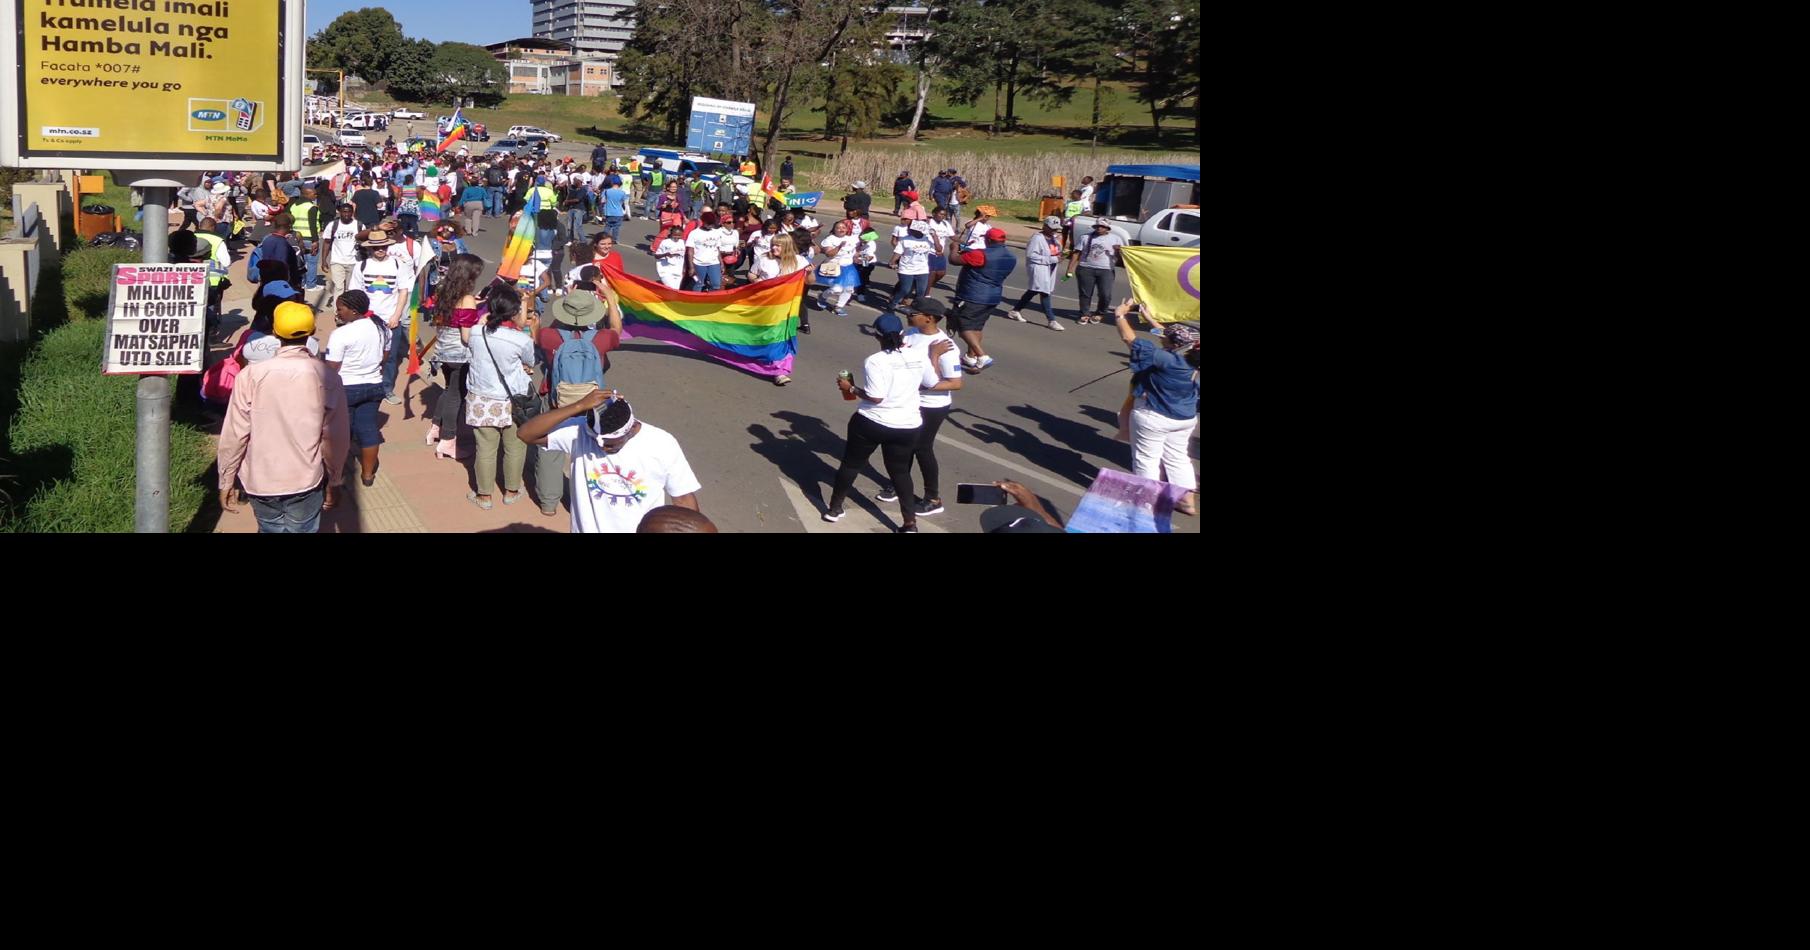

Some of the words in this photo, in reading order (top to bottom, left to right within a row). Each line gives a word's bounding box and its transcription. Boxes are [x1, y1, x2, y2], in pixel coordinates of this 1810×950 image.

[165, 0, 229, 18] imali
[41, 12, 170, 35] kamelula
[178, 23, 228, 43] nga
[41, 35, 141, 55] Hamba
[150, 41, 213, 60] Mali.
[41, 61, 91, 72] Facata
[41, 77, 128, 88] everywhere
[132, 80, 159, 90] you
[162, 82, 182, 92] go
[117, 267, 204, 285] SPORTS
[127, 285, 194, 301] MHLUME
[123, 302, 139, 317] IN
[144, 301, 197, 317] COURT
[139, 319, 179, 334] OVER
[114, 334, 199, 350] MATSAPHA
[120, 351, 151, 366] UTD
[155, 350, 192, 366] SALE
